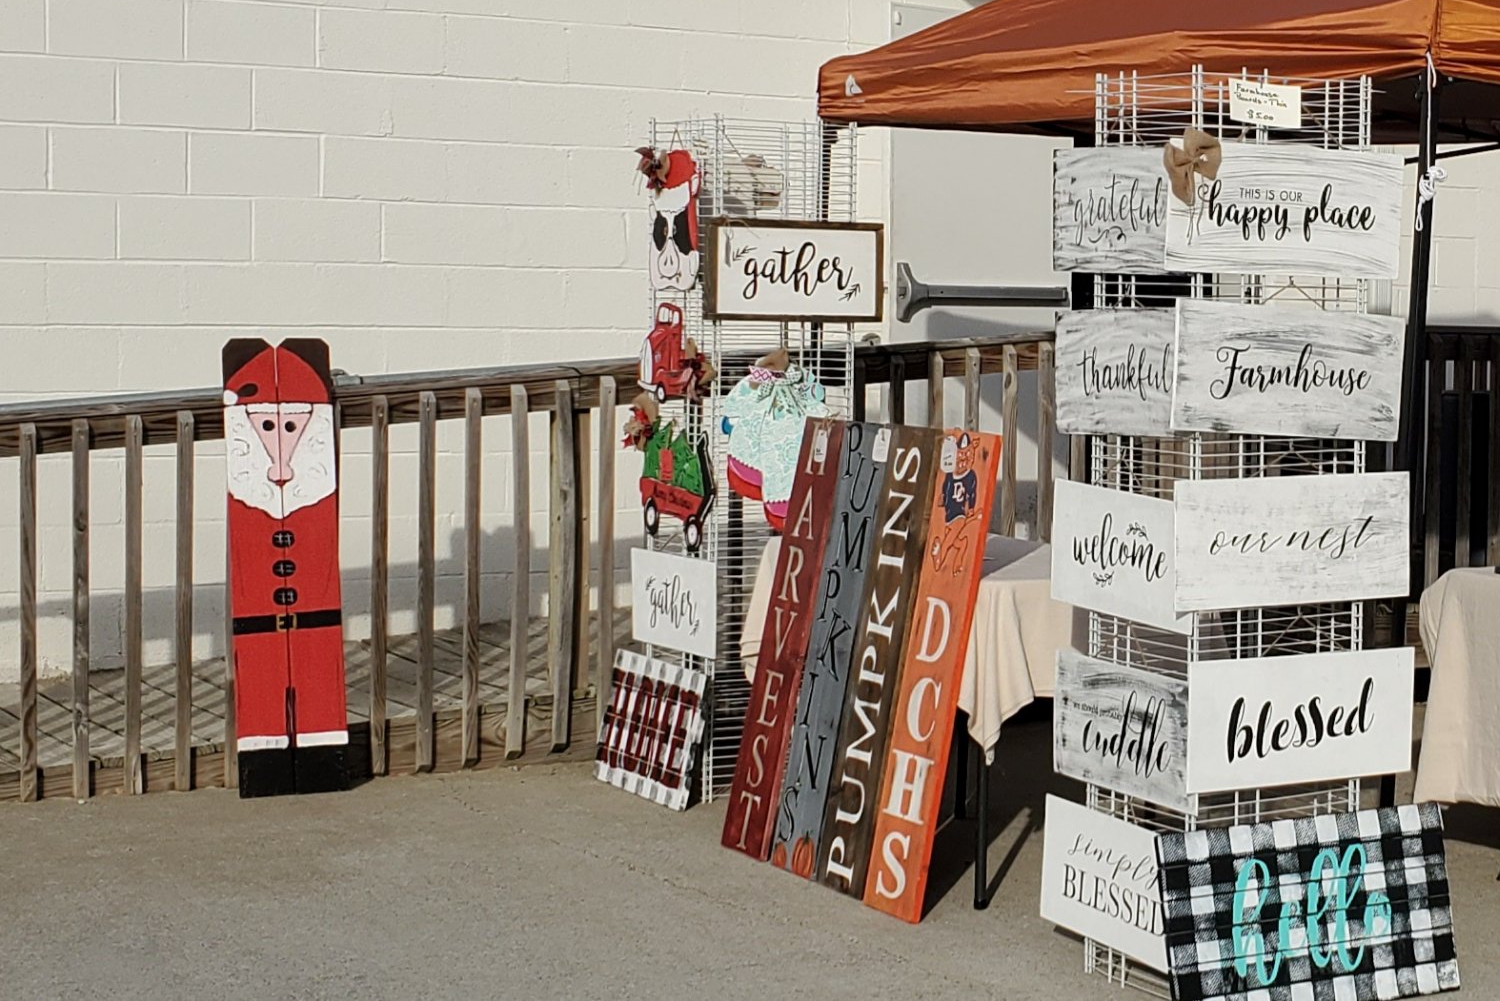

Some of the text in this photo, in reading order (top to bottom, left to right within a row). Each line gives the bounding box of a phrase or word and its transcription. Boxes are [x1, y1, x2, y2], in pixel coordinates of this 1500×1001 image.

[1074, 173, 1165, 246] grateful
[1197, 179, 1375, 242] happy place
[1239, 187, 1303, 202] THIS IS OUR
[743, 241, 853, 299] gather
[1077, 342, 1173, 401] thankful
[1210, 343, 1371, 399] Farmhouse
[1073, 512, 1168, 582] welcome
[1210, 515, 1377, 560] our nest
[650, 575, 697, 629] gather
[735, 421, 836, 850] HARVEST
[779, 422, 880, 842] PUMPKINS
[826, 446, 922, 888] PUMPKINS
[875, 597, 951, 899] DCHS
[1082, 690, 1172, 779] cuddle
[1226, 677, 1376, 764] blessed
[1067, 834, 1159, 890] simply
[1232, 843, 1392, 986] hello
